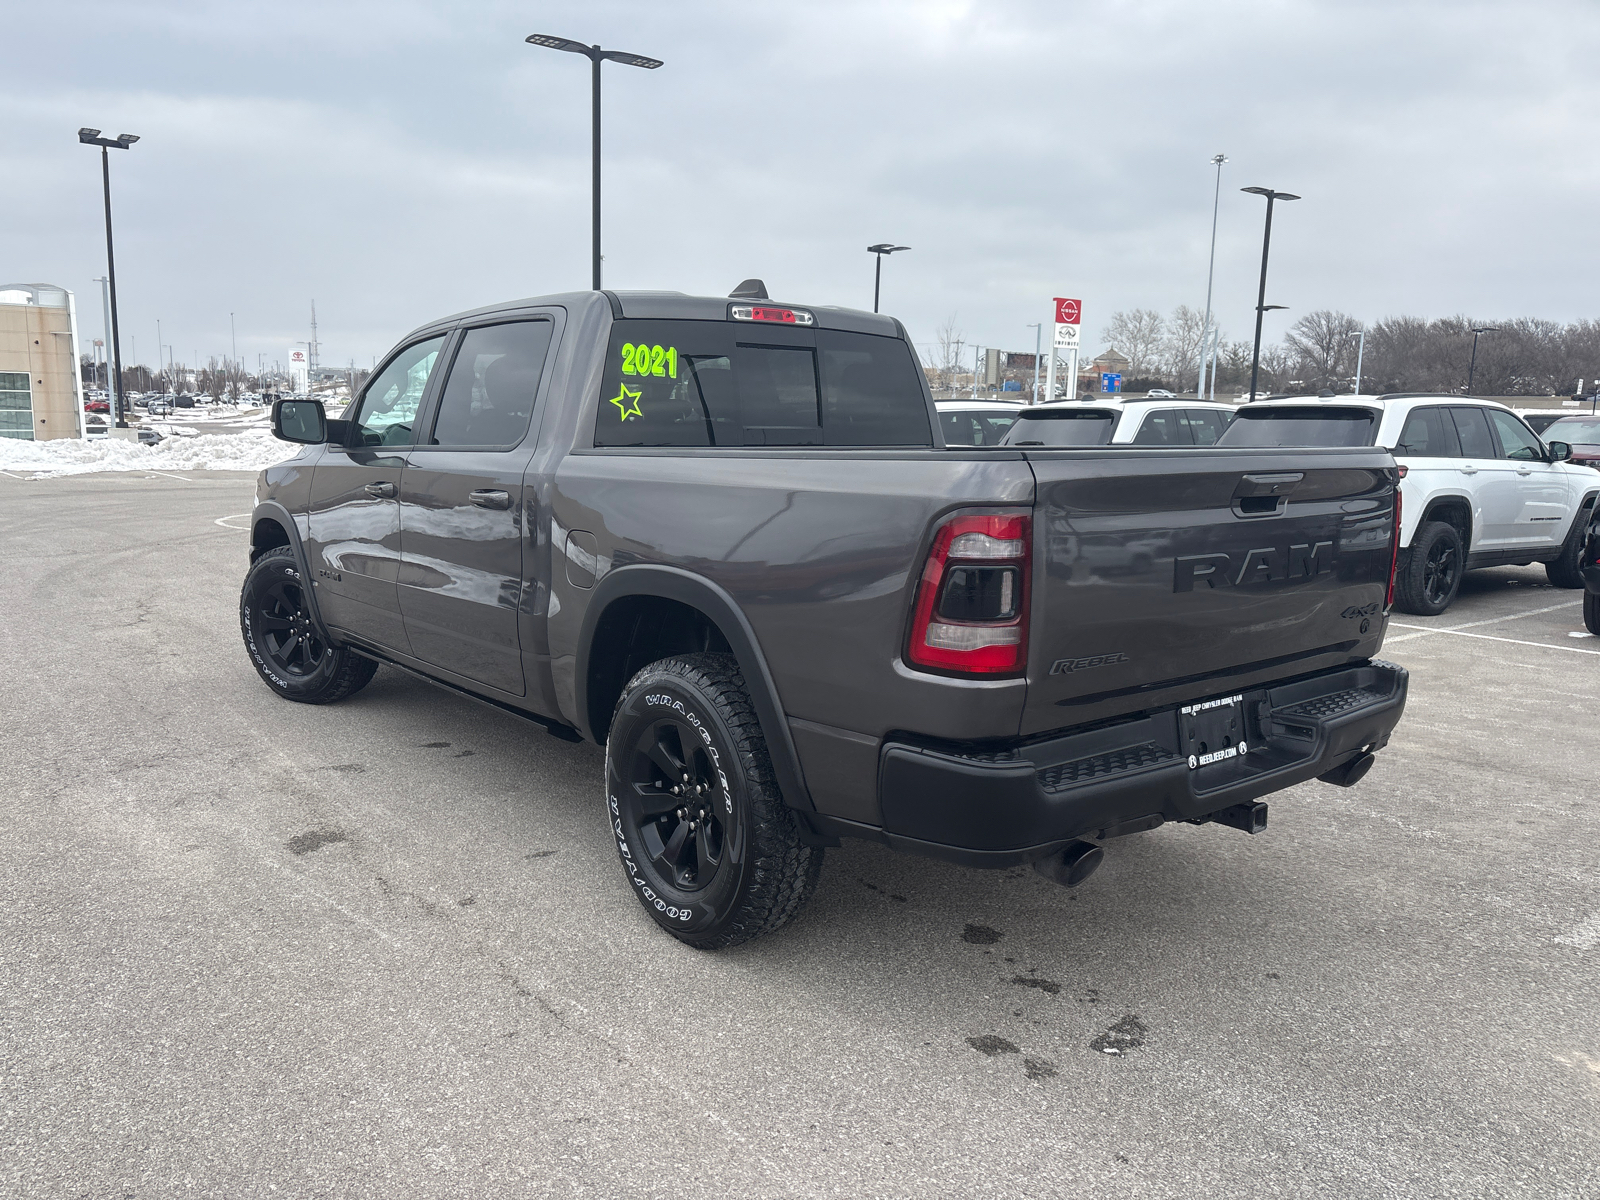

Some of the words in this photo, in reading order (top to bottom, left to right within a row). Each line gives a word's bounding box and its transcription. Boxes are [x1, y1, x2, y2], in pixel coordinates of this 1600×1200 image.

[621, 342, 678, 379] 2021
[1172, 541, 1334, 594] RAM
[1048, 652, 1130, 676] REBEL
[1202, 700, 1220, 710] CHRYSLER
[1221, 697, 1233, 705] DODGE
[1233, 694, 1242, 702] RAM
[645, 694, 733, 814] WRANGLER
[1199, 747, 1237, 765] REEDJEEP.COM
[610, 795, 692, 921] GOODYEAR
